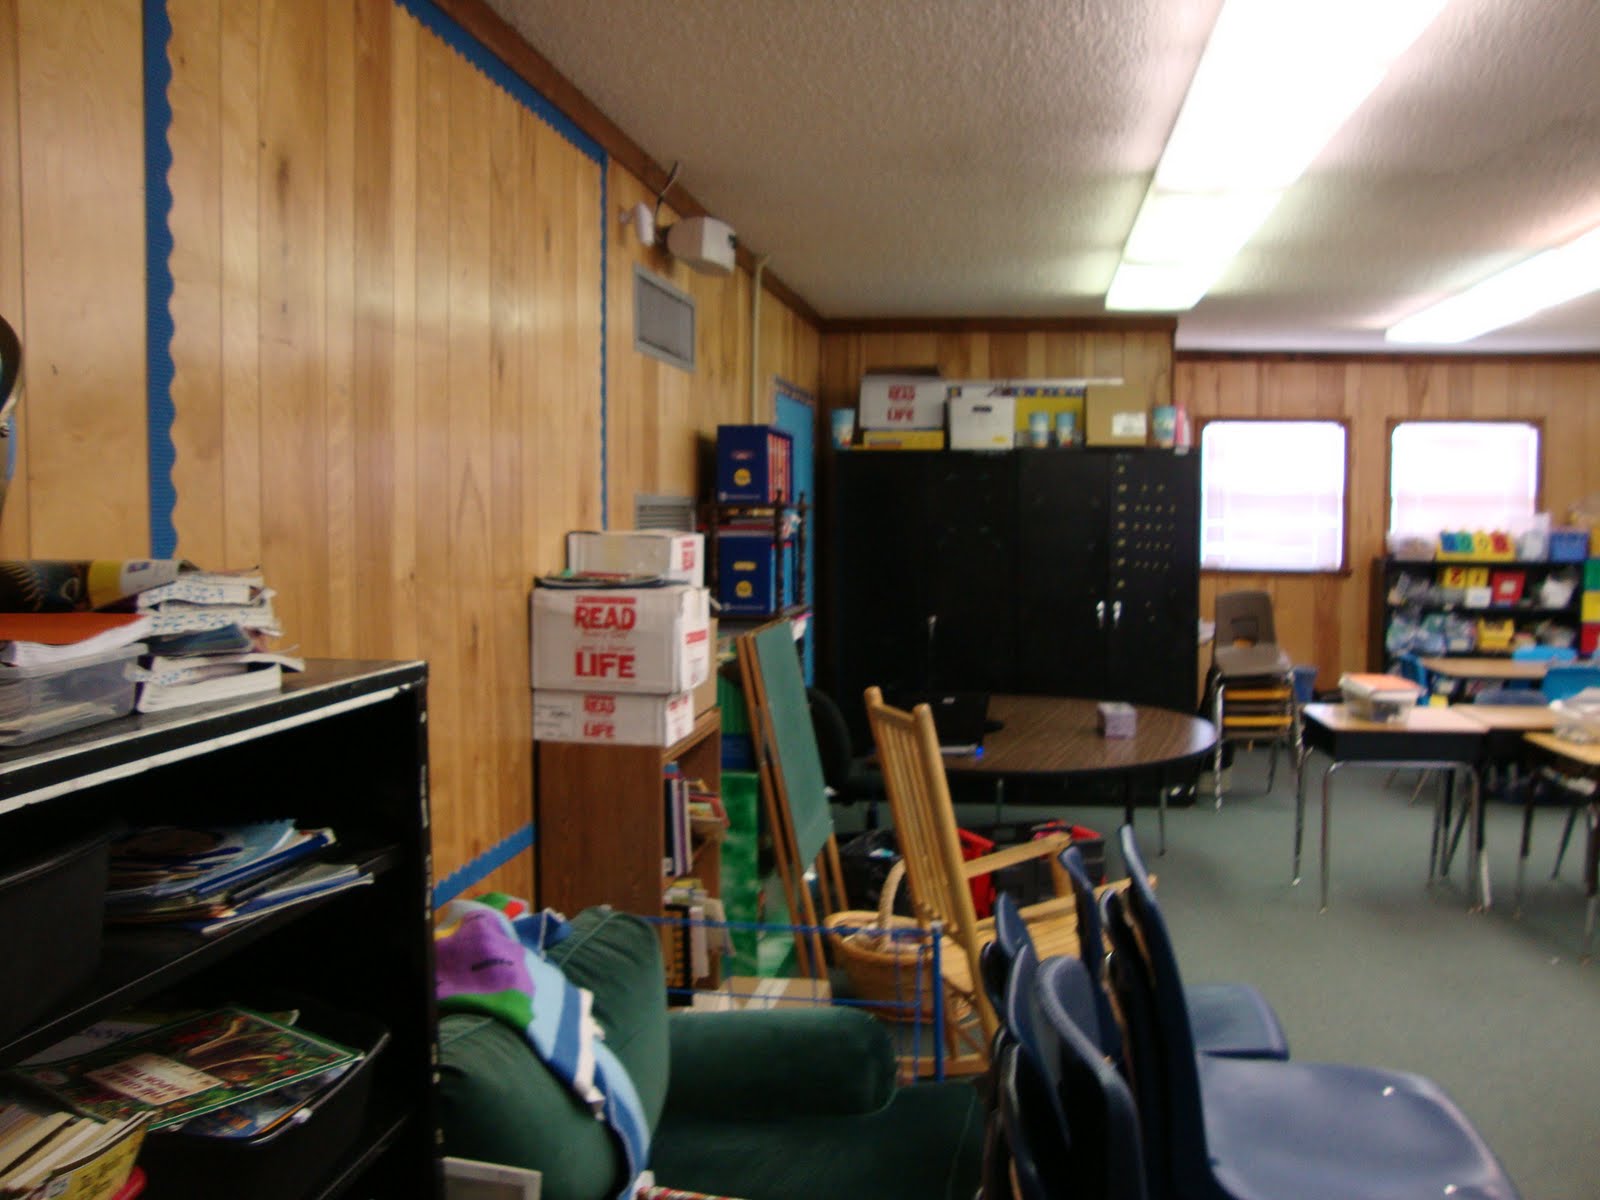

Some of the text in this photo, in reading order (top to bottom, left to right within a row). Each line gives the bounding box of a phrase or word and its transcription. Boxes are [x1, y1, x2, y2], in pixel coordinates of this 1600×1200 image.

[575, 606, 636, 630] READ
[575, 652, 636, 678] LIFE
[583, 699, 615, 715] READ
[583, 723, 615, 738] LIFE
